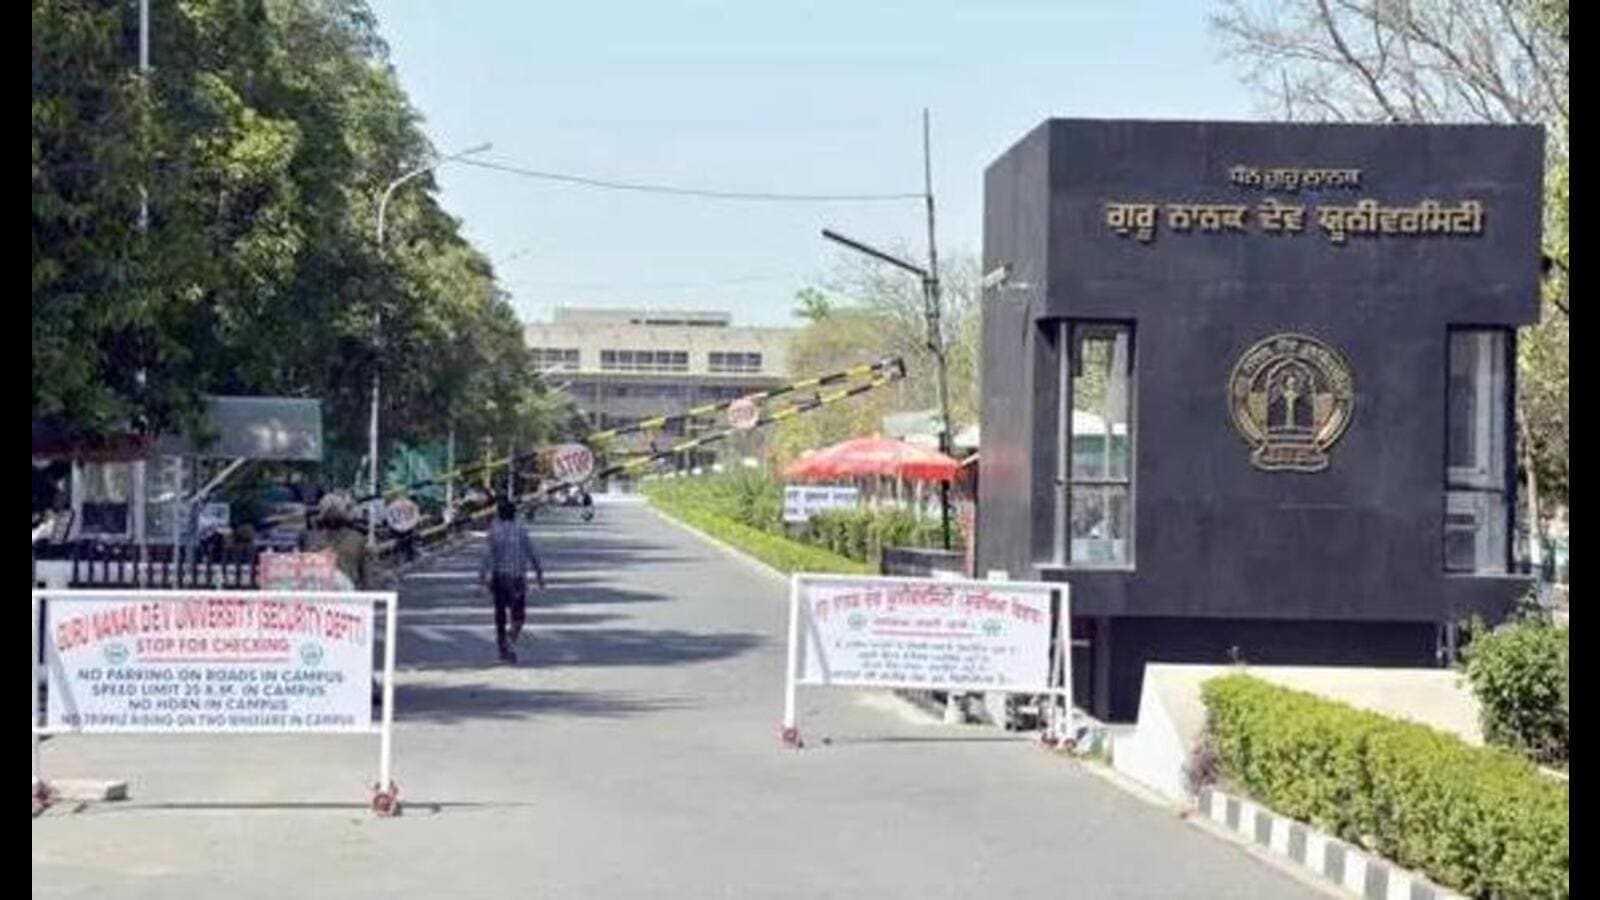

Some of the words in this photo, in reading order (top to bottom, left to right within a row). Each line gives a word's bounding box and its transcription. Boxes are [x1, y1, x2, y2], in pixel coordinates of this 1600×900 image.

[1106, 202, 1158, 241] ਗੁਰੂ
[1166, 203, 1247, 231] ਨਾਨਕ
[1258, 198, 1304, 231] ਦੇਵ
[1317, 198, 1484, 243] ਯੂਨੀਵਰਸਿਟੀ
[142, 602, 172, 632] DEV
[136, 638, 175, 653] STOP
[179, 638, 208, 653] FOR
[212, 638, 290, 652] CHECKING
[78, 668, 102, 680] NO
[106, 668, 173, 681] PARKING
[177, 669, 202, 681] ON
[205, 669, 258, 682] ROADS
[261, 670, 278, 682] IN
[281, 670, 343, 683] CAMPUS
[91, 683, 137, 696] SPEED
[141, 684, 180, 696] LIMIT
[241, 685, 258, 696] IN
[263, 685, 327, 697] CAMPUS
[128, 700, 151, 711] NO
[157, 700, 200, 711] HORN
[205, 700, 222, 710] IN
[226, 700, 289, 711] CAMPUS
